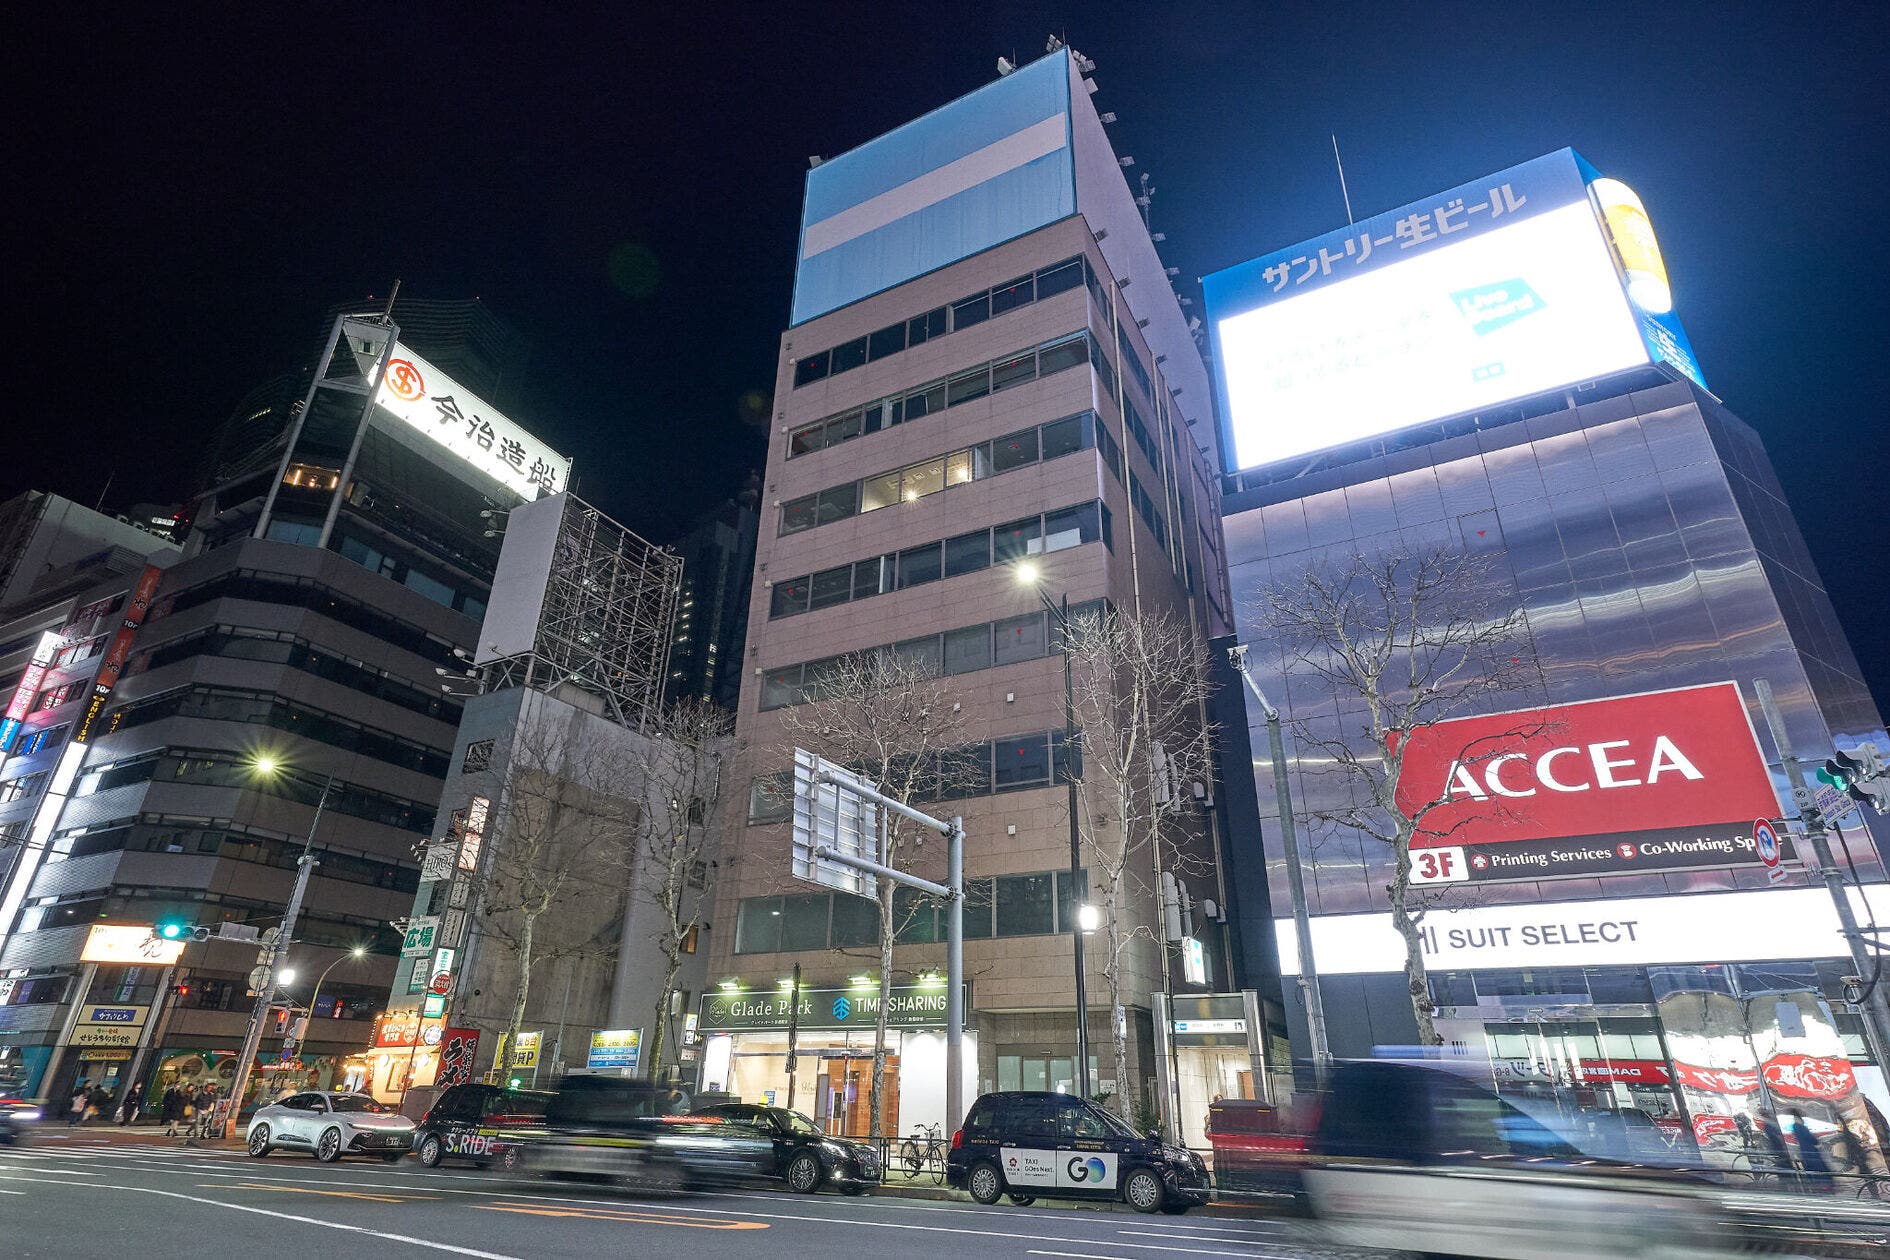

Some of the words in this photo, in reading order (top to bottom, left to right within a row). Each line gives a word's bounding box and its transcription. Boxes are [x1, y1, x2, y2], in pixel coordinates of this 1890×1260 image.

[1262, 184, 1527, 293] サントリー生ビール
[431, 395, 557, 491] 今治造船
[1442, 735, 1704, 802] ACCEA
[1491, 850, 1549, 869] Printing
[1551, 845, 1612, 864] Services
[1639, 836, 1731, 858] Co-Working
[1734, 834, 1783, 852] Spe
[1418, 851, 1454, 878] 3F
[403, 926, 434, 949] 広場
[1448, 926, 1512, 949] SUIT
[1522, 920, 1638, 946] SELECT
[731, 1000, 772, 1016] Glade
[888, 995, 947, 1012] SHARING
[445, 1133, 498, 1156] S.RIDE
[1067, 1156, 1106, 1183] GO
